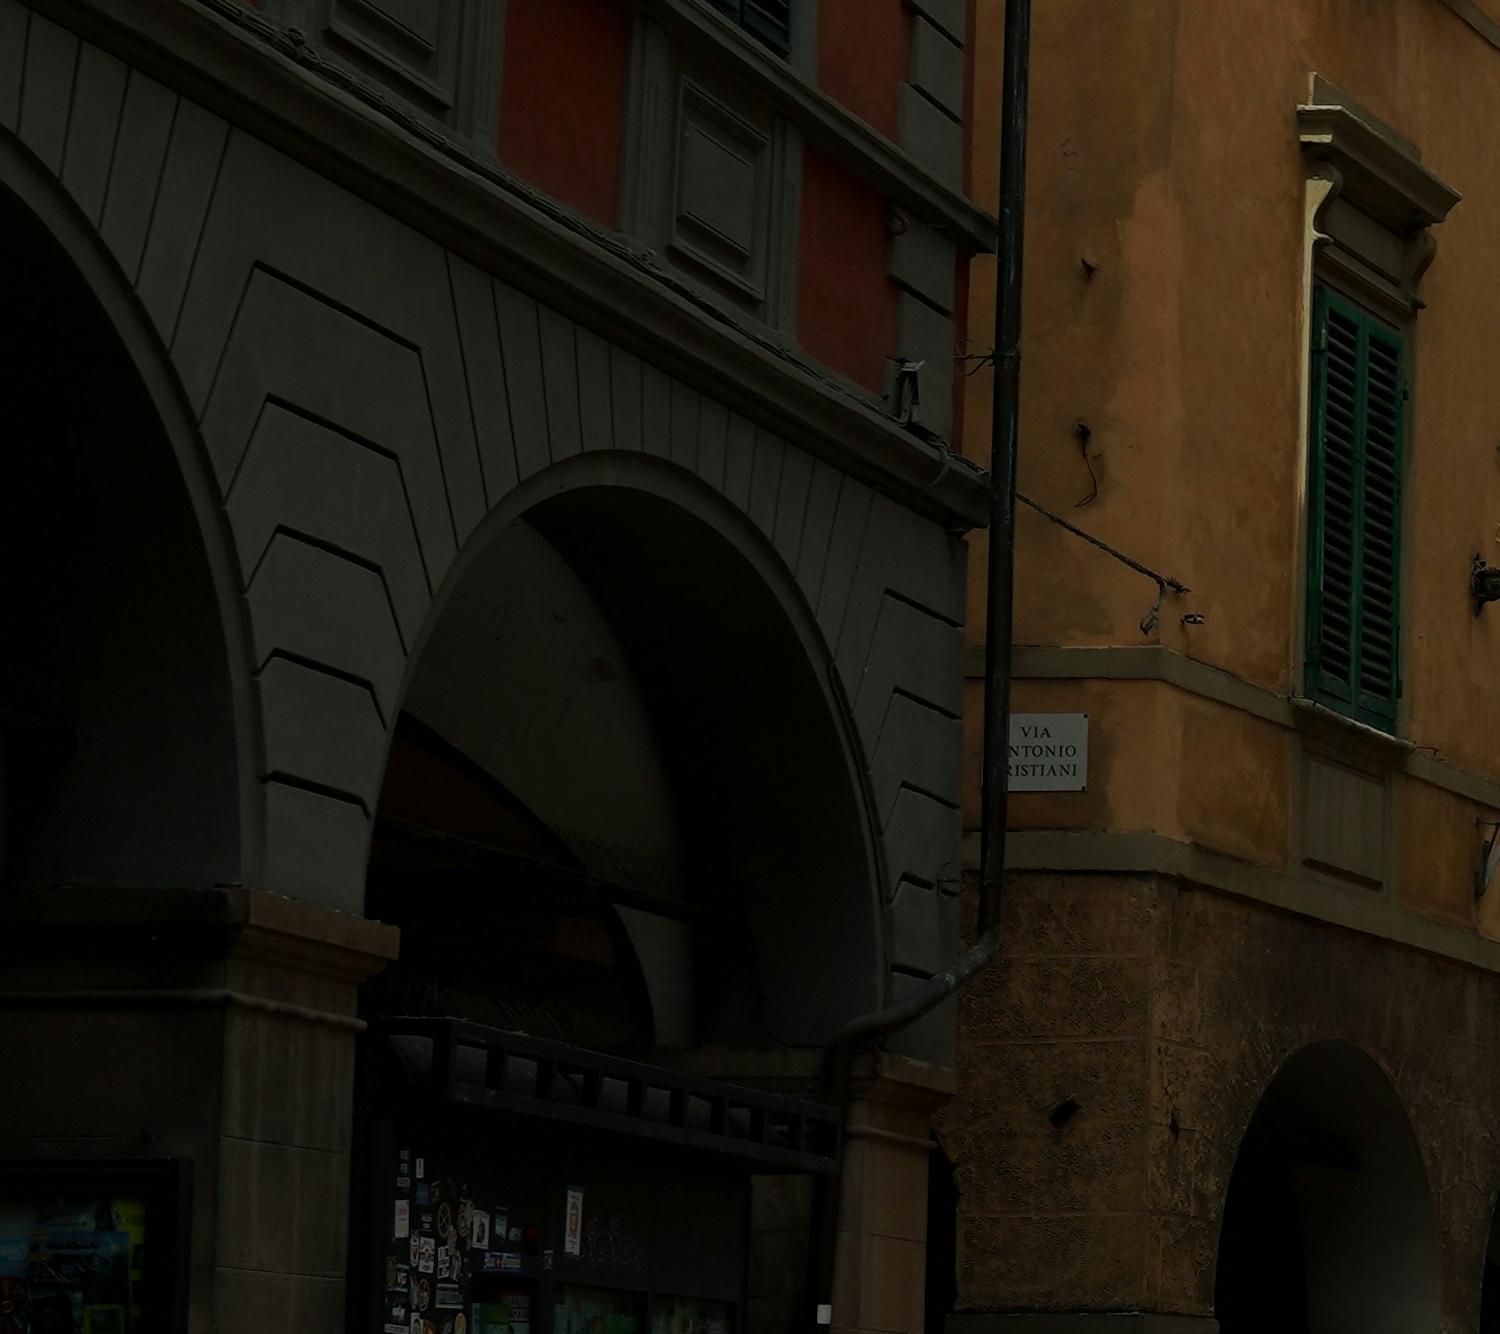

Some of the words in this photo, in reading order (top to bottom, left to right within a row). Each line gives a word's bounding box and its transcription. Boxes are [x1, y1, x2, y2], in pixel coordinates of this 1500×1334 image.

[1021, 727, 1051, 738] VIA
[1009, 745, 1076, 757] NTONIO
[1007, 765, 1076, 776] RISTIANI
